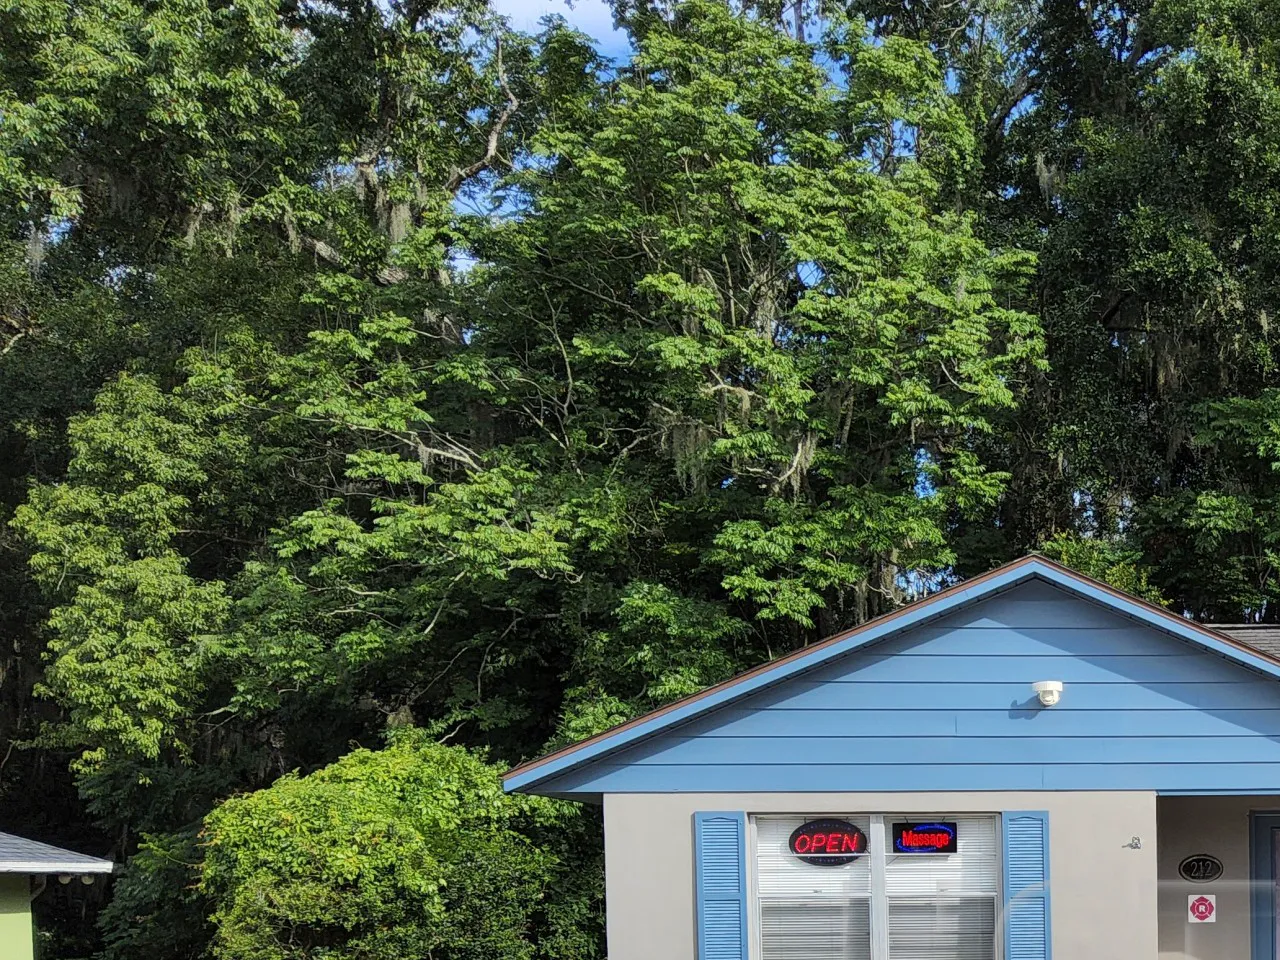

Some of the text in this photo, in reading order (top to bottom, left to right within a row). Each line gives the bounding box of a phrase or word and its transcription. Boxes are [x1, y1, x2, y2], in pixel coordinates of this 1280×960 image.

[794, 832, 859, 853] OPEN
[901, 830, 950, 848] Massage
[1190, 861, 1212, 877] 212
